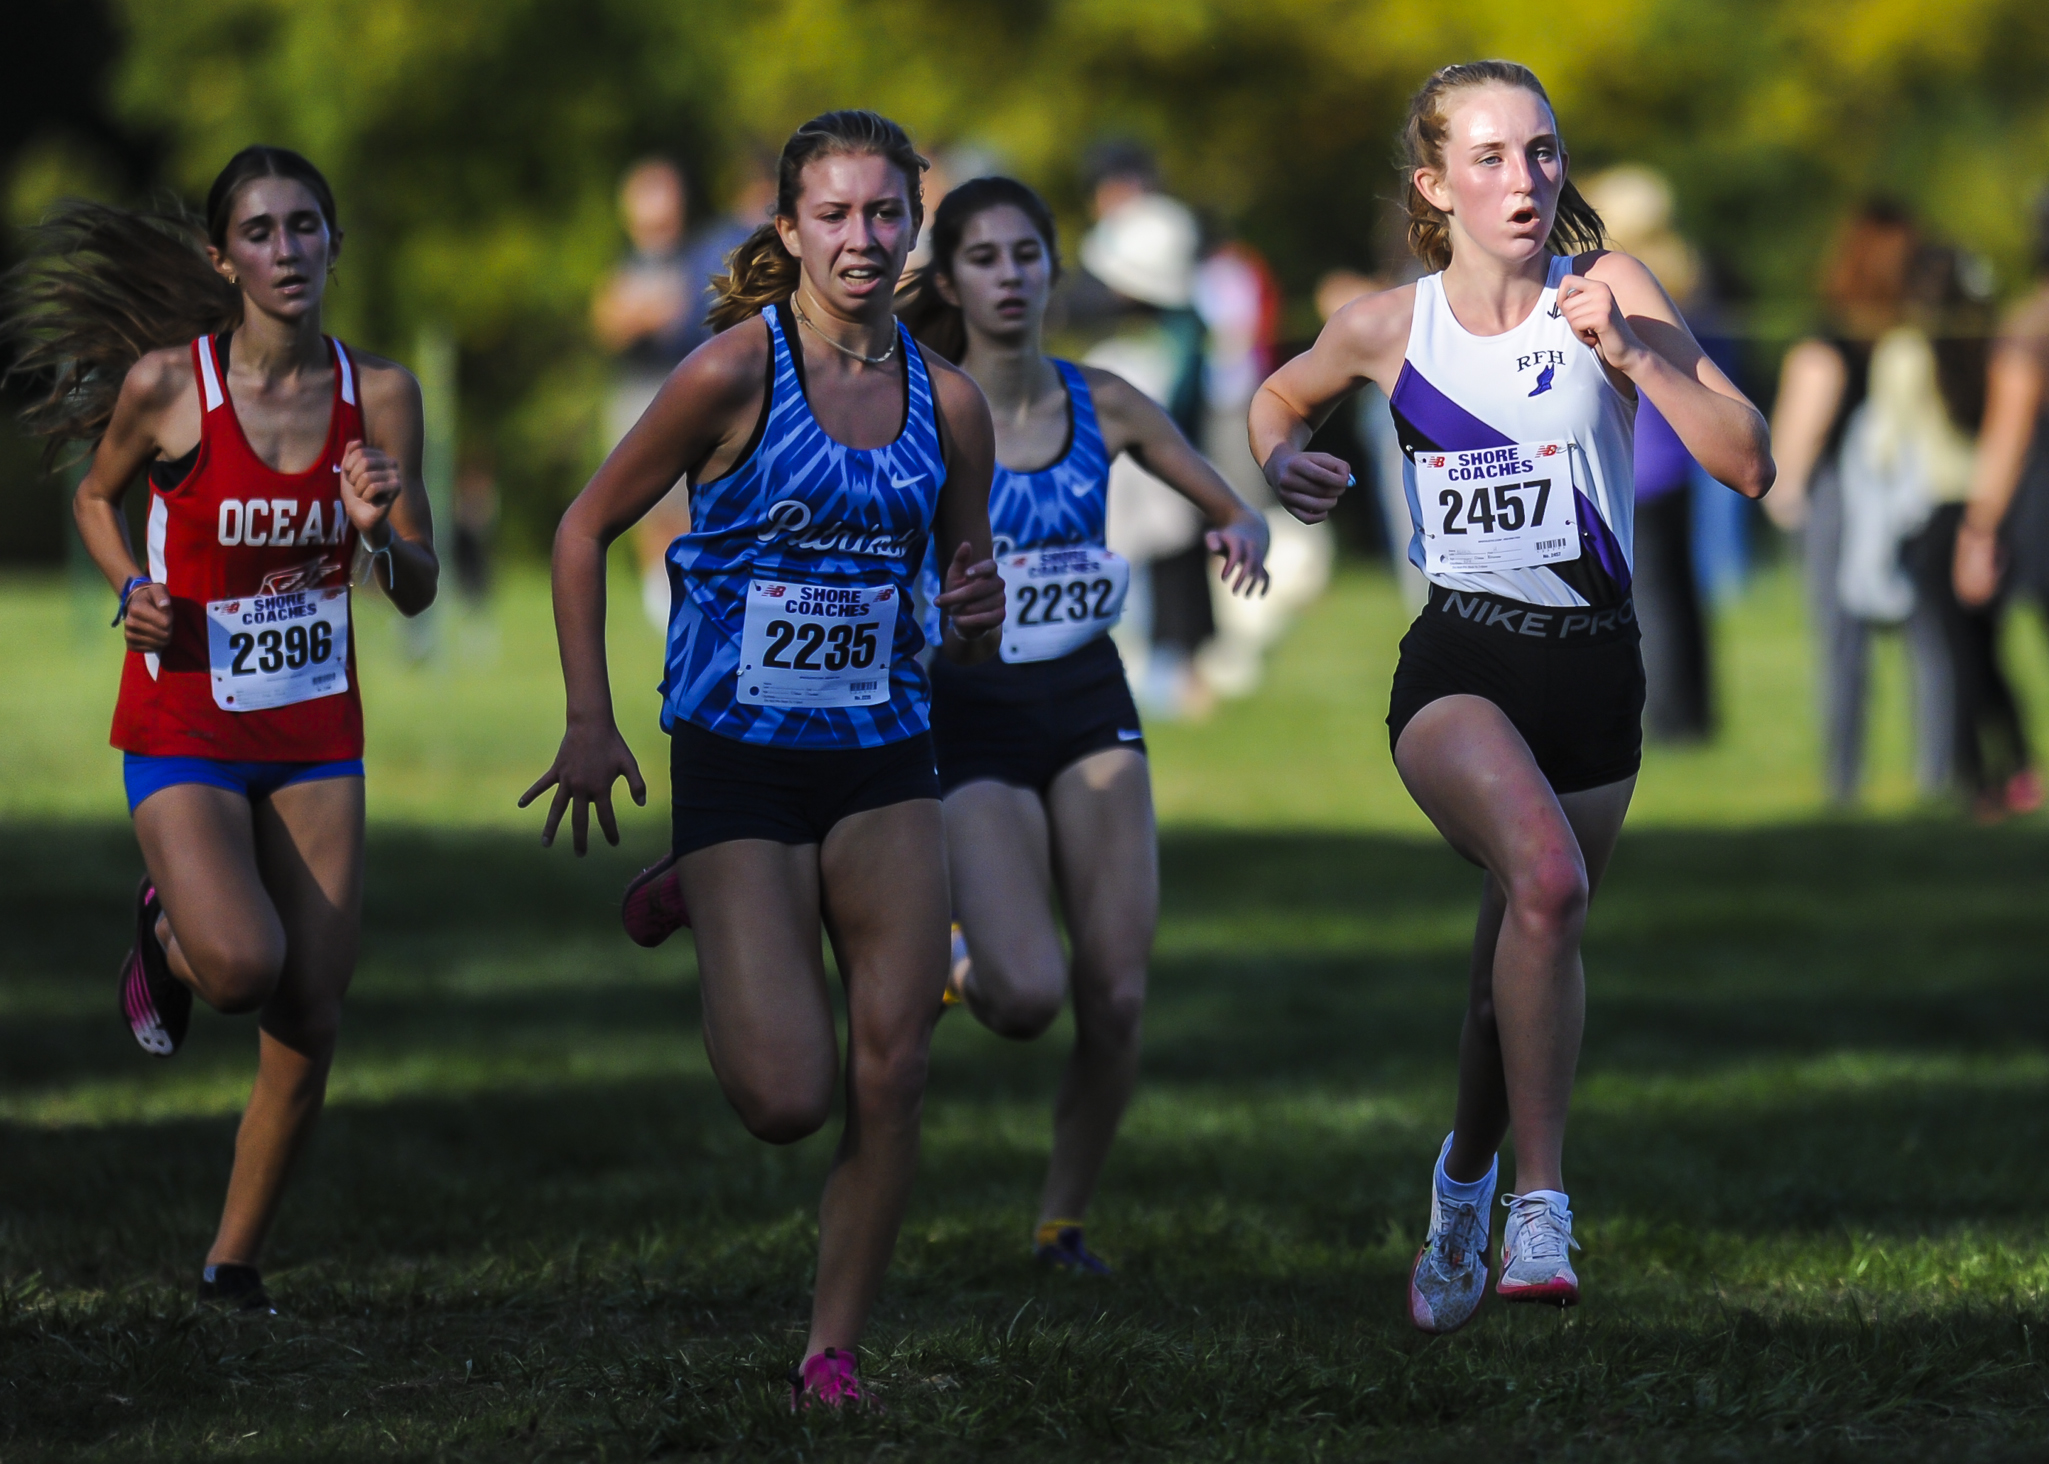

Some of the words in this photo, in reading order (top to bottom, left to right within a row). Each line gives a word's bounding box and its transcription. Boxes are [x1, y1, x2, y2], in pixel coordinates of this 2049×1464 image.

[1516, 350, 1566, 372] RFH
[1458, 447, 1519, 466] SHORE
[1448, 460, 1534, 481] COACHES
[1438, 478, 1552, 535] 2457
[253, 593, 306, 612] SHORE
[800, 587, 862, 603] SHORE
[1017, 578, 1113, 626] 2232
[242, 603, 317, 625] COACHES
[785, 600, 870, 617] COACHES
[1442, 591, 1553, 637] NIKE
[1559, 598, 1634, 638] PRO
[229, 620, 332, 677] 2396
[762, 619, 880, 672] 2235
